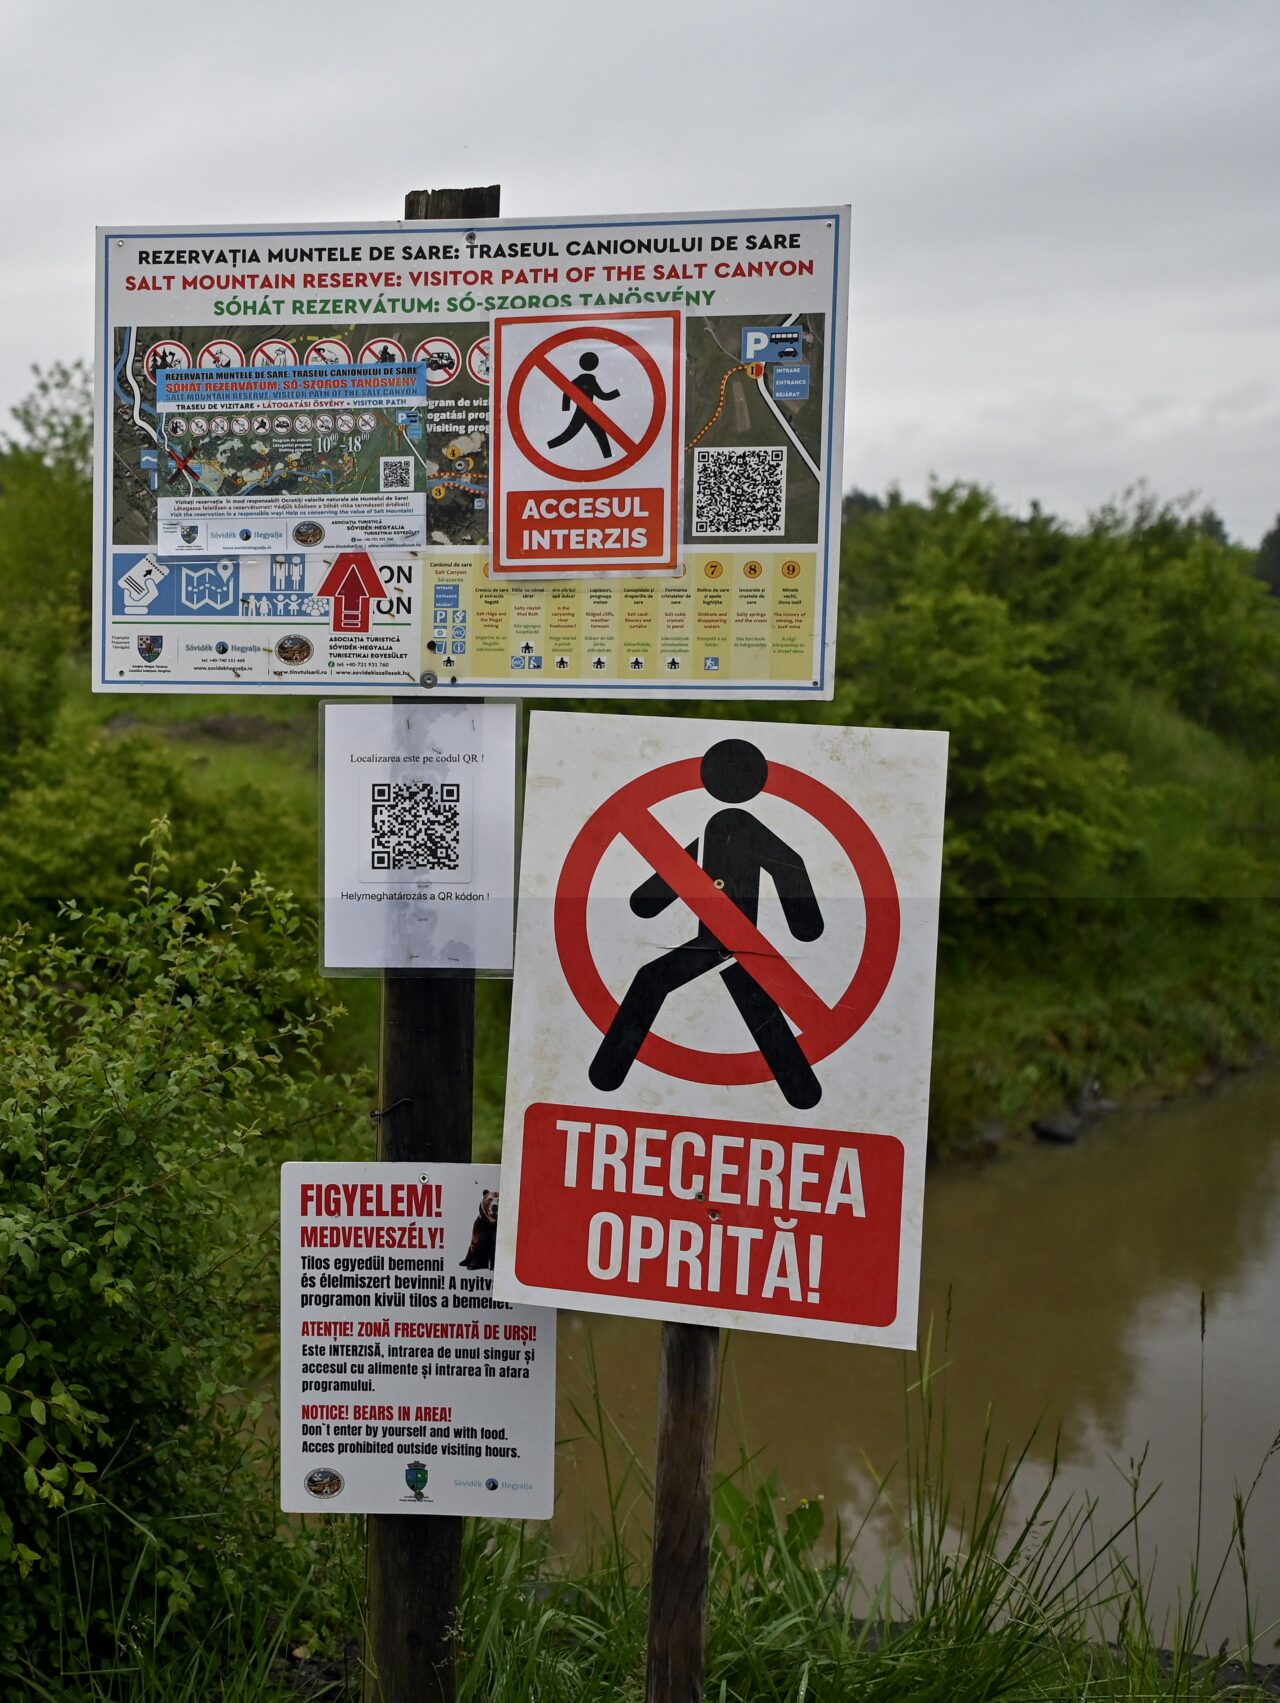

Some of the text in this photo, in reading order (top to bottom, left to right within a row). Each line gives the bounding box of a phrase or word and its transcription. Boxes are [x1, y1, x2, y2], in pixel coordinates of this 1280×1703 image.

[138, 233, 801, 267] REZERVAȚIA MUNTELE DE SARE: TRASEUL CANIONULUI DE SARE
[125, 260, 814, 291] SALT MOUNTAIN RESERVE: VISITOR PATH OF THE SALT CANYON
[213, 295, 286, 316] SÓHÁT
[292, 293, 440, 315] REZERVÁTUM:
[447, 291, 572, 313] SÓ-SZOROS
[216, 372, 253, 380] MUNTELE
[254, 371, 265, 379] DE
[292, 370, 328, 378] TRASEUL
[330, 368, 381, 377] CANIONULUI
[395, 367, 418, 375] SARE
[165, 382, 202, 393] SÓHÁT
[166, 393, 185, 401] SALT
[186, 392, 230, 401] MOUNTAIN
[273, 391, 307, 399] VISITOR
[309, 390, 330, 398] PATH
[344, 389, 359, 397] THE
[361, 388, 380, 396] SALT
[383, 387, 417, 396] CANYON
[262, 400, 311, 409] LÁTOGATÁSI
[427, 398, 489, 409] gram de viz
[427, 410, 490, 421] ogatási prog
[426, 423, 490, 434] Visiting prog
[521, 497, 649, 519] ACCESUL
[522, 527, 647, 550] INTERZIS
[378, 565, 412, 584] ON
[709, 565, 718, 575] 7
[748, 565, 757, 575] 8
[787, 565, 795, 575] 9
[185, 644, 261, 653] Sóvidék Hegyalja
[350, 754, 401, 764] Localizarea
[403, 755, 420, 763] este
[423, 756, 433, 765] pe
[436, 753, 460, 763] codul
[462, 754, 478, 765] QR
[341, 891, 427, 903] Helymeghatározás
[438, 892, 453, 902] QR
[455, 891, 484, 902] kódon
[556, 1119, 866, 1218] TRECEREA
[300, 1184, 442, 1217] FIGYELEM!
[300, 1222, 444, 1249] MEDVEVESZÉLY!
[301, 1256, 444, 1275] Tilos egyedül bemenni
[586, 1211, 823, 1304] OPRITĂ!
[301, 1273, 493, 1293] és élelmiszert bevinni! A nyitv
[301, 1295, 371, 1308] programon
[374, 1292, 405, 1307] kivül
[409, 1293, 437, 1308] tilos
[441, 1297, 449, 1308] a
[302, 1319, 537, 1346] ATENȚIE! ZONĂ FRECVENTATĂ DE URȘI!
[302, 1342, 535, 1365] Este INTERZISĂ, intrarea de unul singur și
[302, 1361, 530, 1380] accesul cu alimente și intrarea în afara
[302, 1379, 376, 1393] programului.
[302, 1404, 452, 1422] NOTICE! BEARS IN AREA!
[333, 1424, 362, 1437] enter
[365, 1424, 378, 1438] by
[382, 1424, 427, 1438] yourself
[429, 1425, 450, 1438] and
[453, 1426, 477, 1440] with
[480, 1427, 508, 1440] food.
[302, 1441, 521, 1458] Acces prohibited outside visiting hours.
